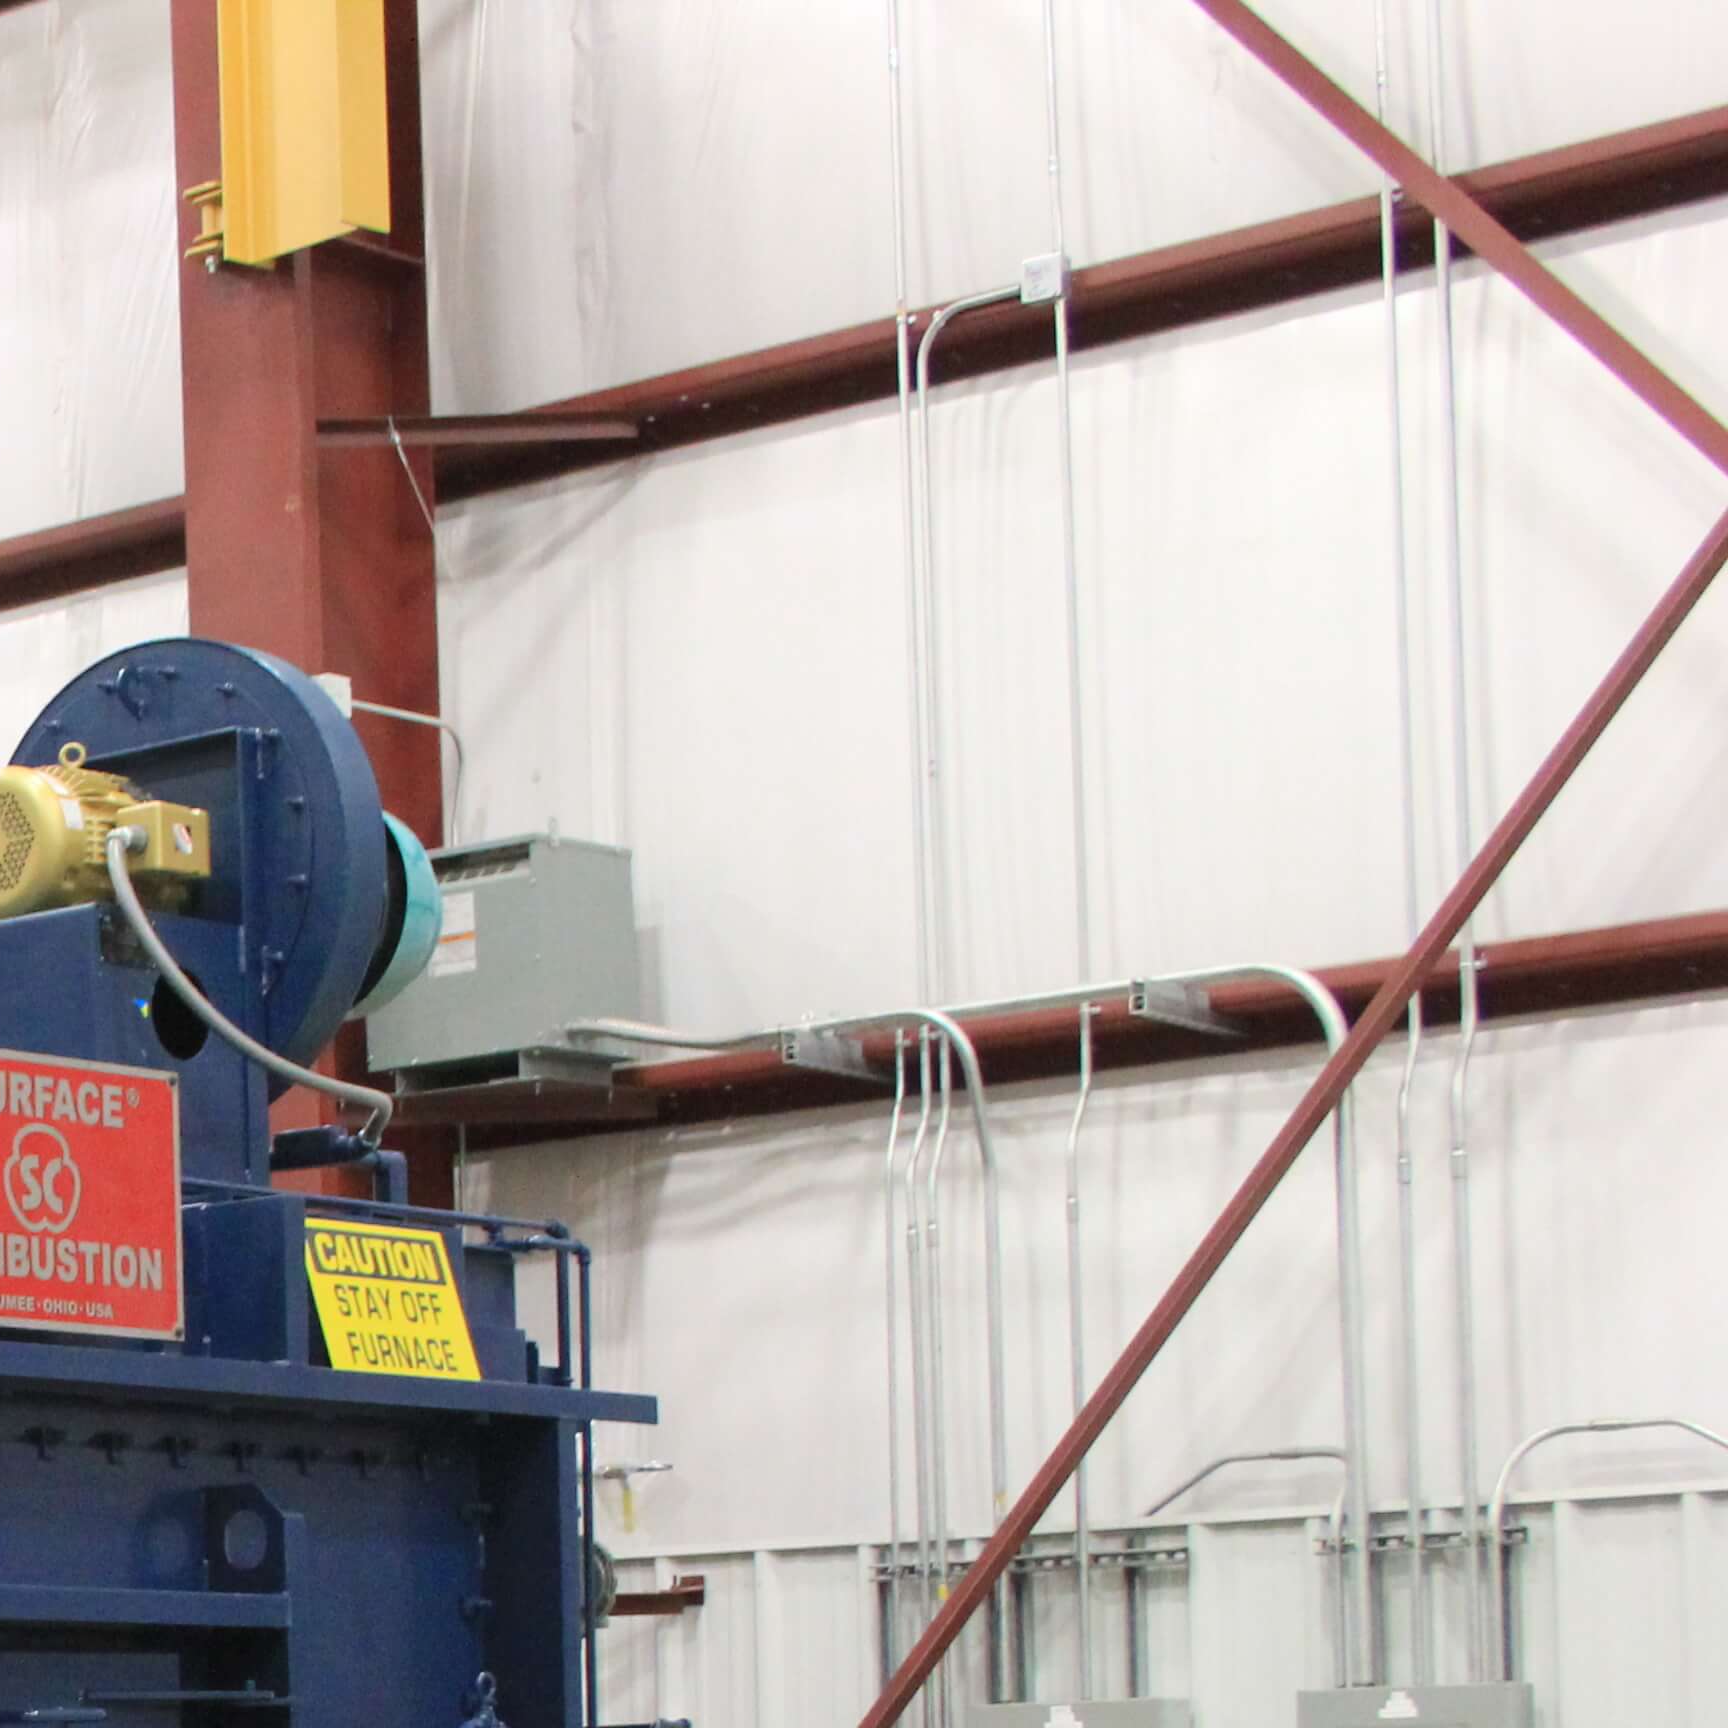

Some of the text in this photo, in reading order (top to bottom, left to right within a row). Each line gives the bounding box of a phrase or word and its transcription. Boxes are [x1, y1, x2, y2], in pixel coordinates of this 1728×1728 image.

[19, 1154, 64, 1214] SC
[314, 1232, 441, 1281] CAUTION
[334, 1284, 442, 1326] STAY OFF
[346, 1331, 459, 1372] FURNACE
